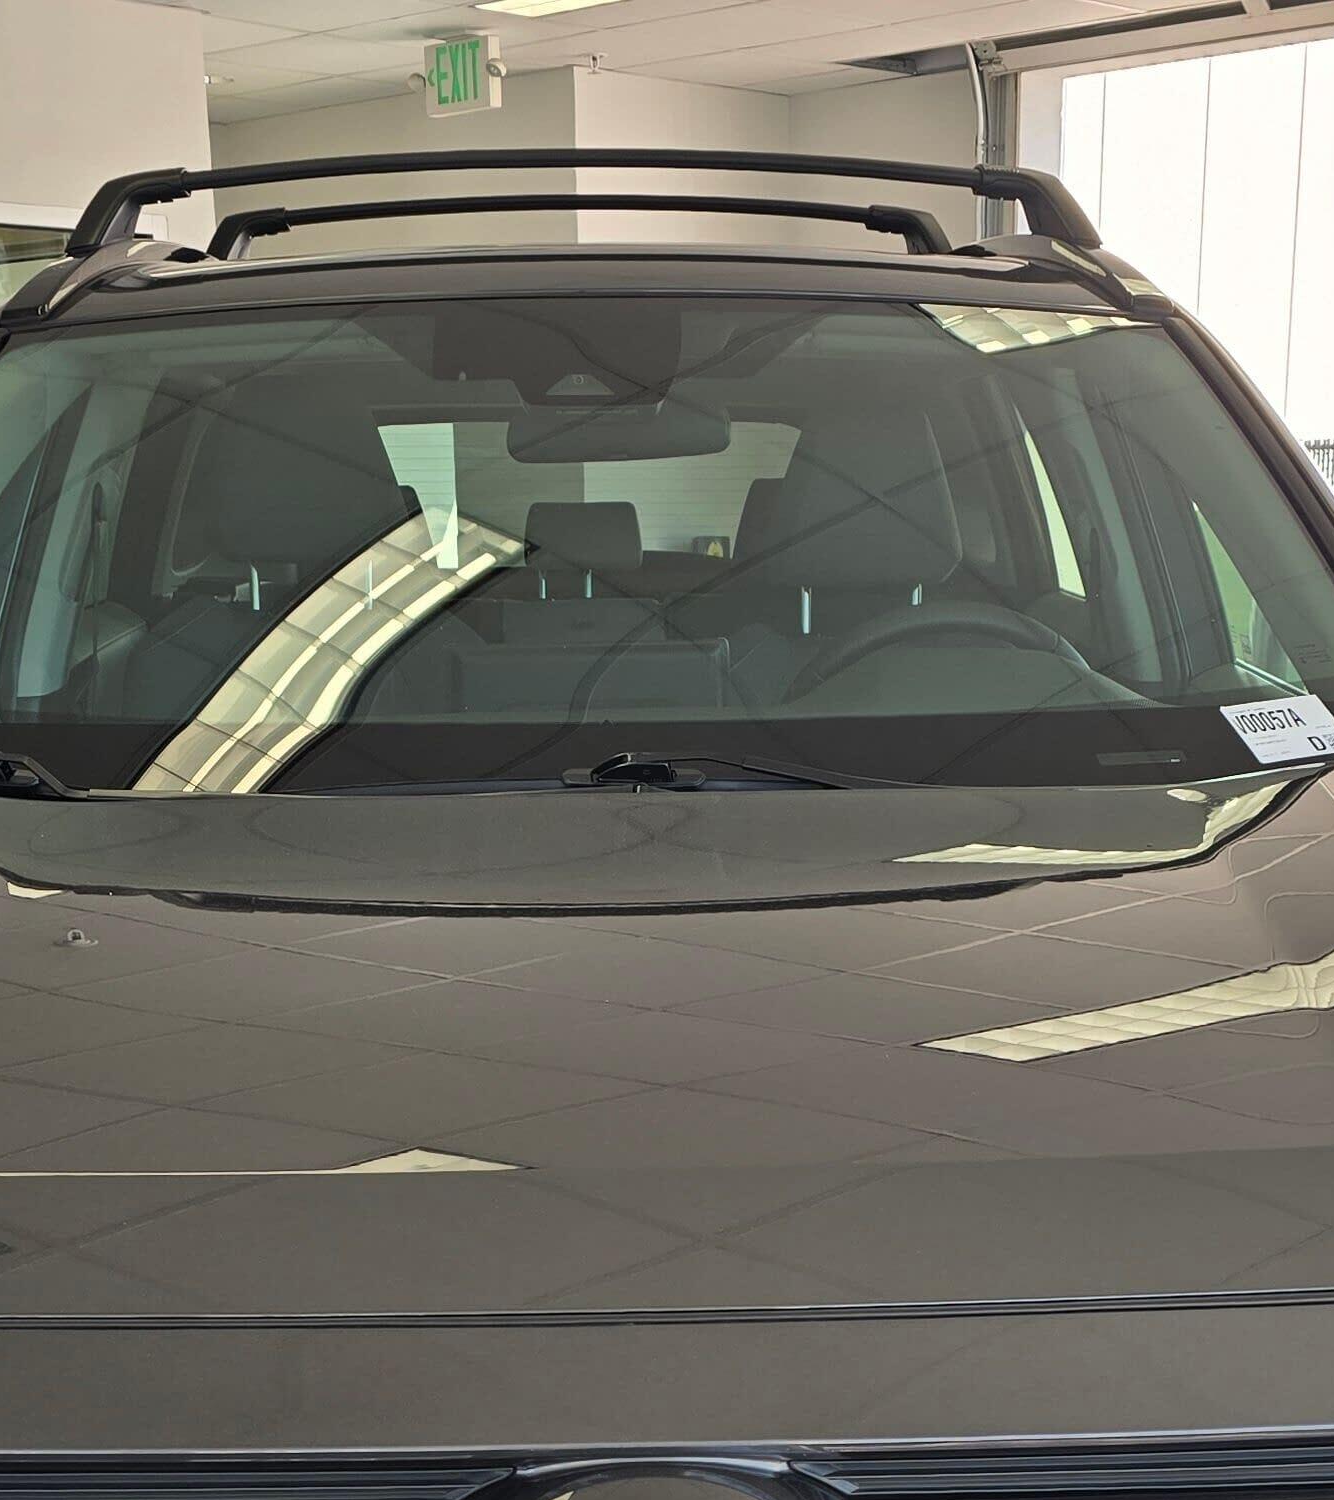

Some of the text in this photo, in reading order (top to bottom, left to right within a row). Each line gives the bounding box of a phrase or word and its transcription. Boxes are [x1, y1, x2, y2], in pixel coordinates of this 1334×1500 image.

[436, 40, 479, 104] EXIT
[1234, 708, 1307, 734] V00057A
[1307, 736, 1326, 750] D
